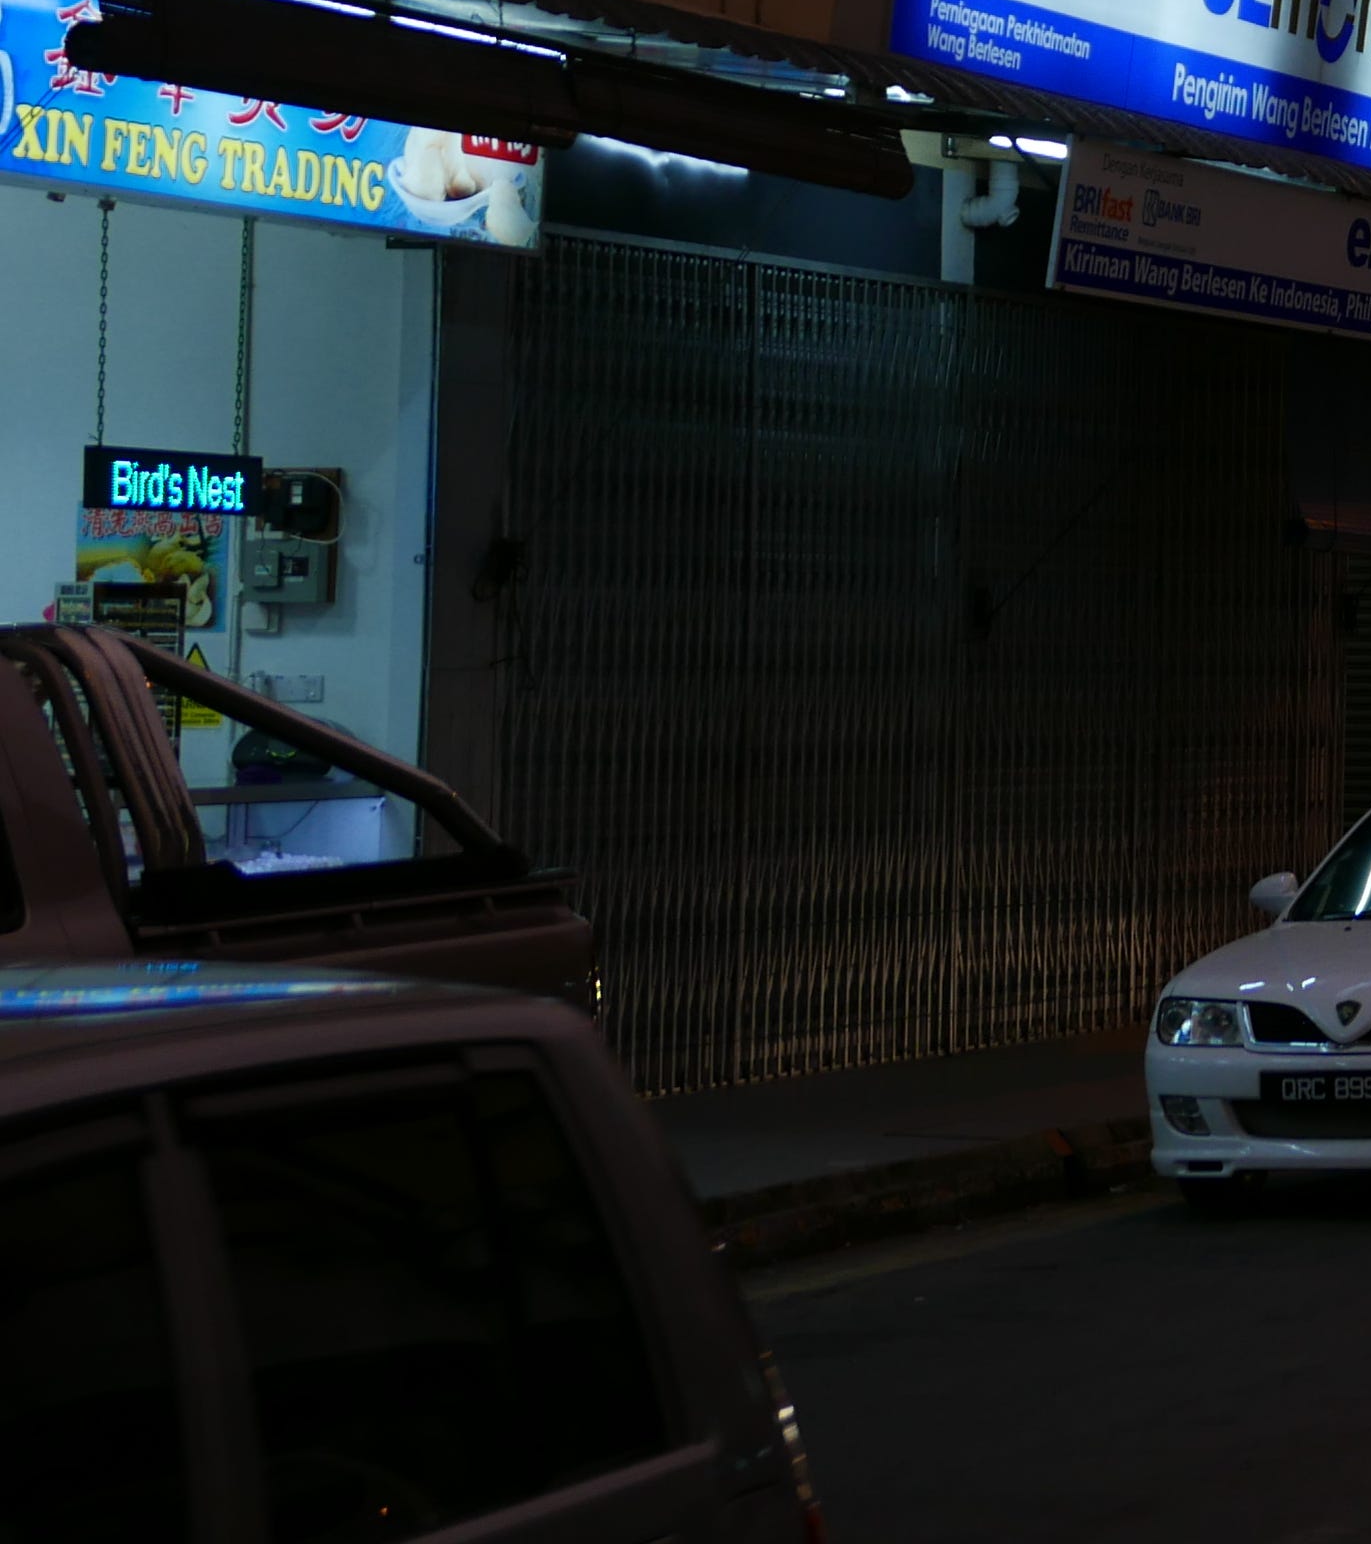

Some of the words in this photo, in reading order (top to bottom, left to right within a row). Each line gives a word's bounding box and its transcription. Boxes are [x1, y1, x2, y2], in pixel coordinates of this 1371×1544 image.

[927, 24, 967, 61] Wang
[967, 35, 1022, 70] Berlesen
[1006, 14, 1091, 60] Perkhidmatan
[1172, 62, 1248, 120] Pengirim
[1252, 82, 1298, 139] Wang
[1301, 96, 1368, 148] Berlesen
[13, 103, 93, 167] XIN
[102, 119, 206, 185] FENG
[218, 136, 385, 213] TRADING
[1102, 152, 1138, 180] Dengan
[1139, 160, 1184, 187] Kerjasama
[1072, 183, 1134, 222] BRIfast
[1158, 198, 1186, 223] BANK
[1069, 214, 1129, 241] Remittance
[1063, 243, 1129, 281] Kiriman
[1132, 255, 1179, 296] Wang
[1180, 262, 1247, 301] Berlesen
[1249, 275, 1268, 304] Ke
[1270, 278, 1341, 322] Indonesia,
[111, 460, 183, 511] Bird's
[188, 465, 245, 514] Nest
[1282, 1078, 1326, 1100] QRC
